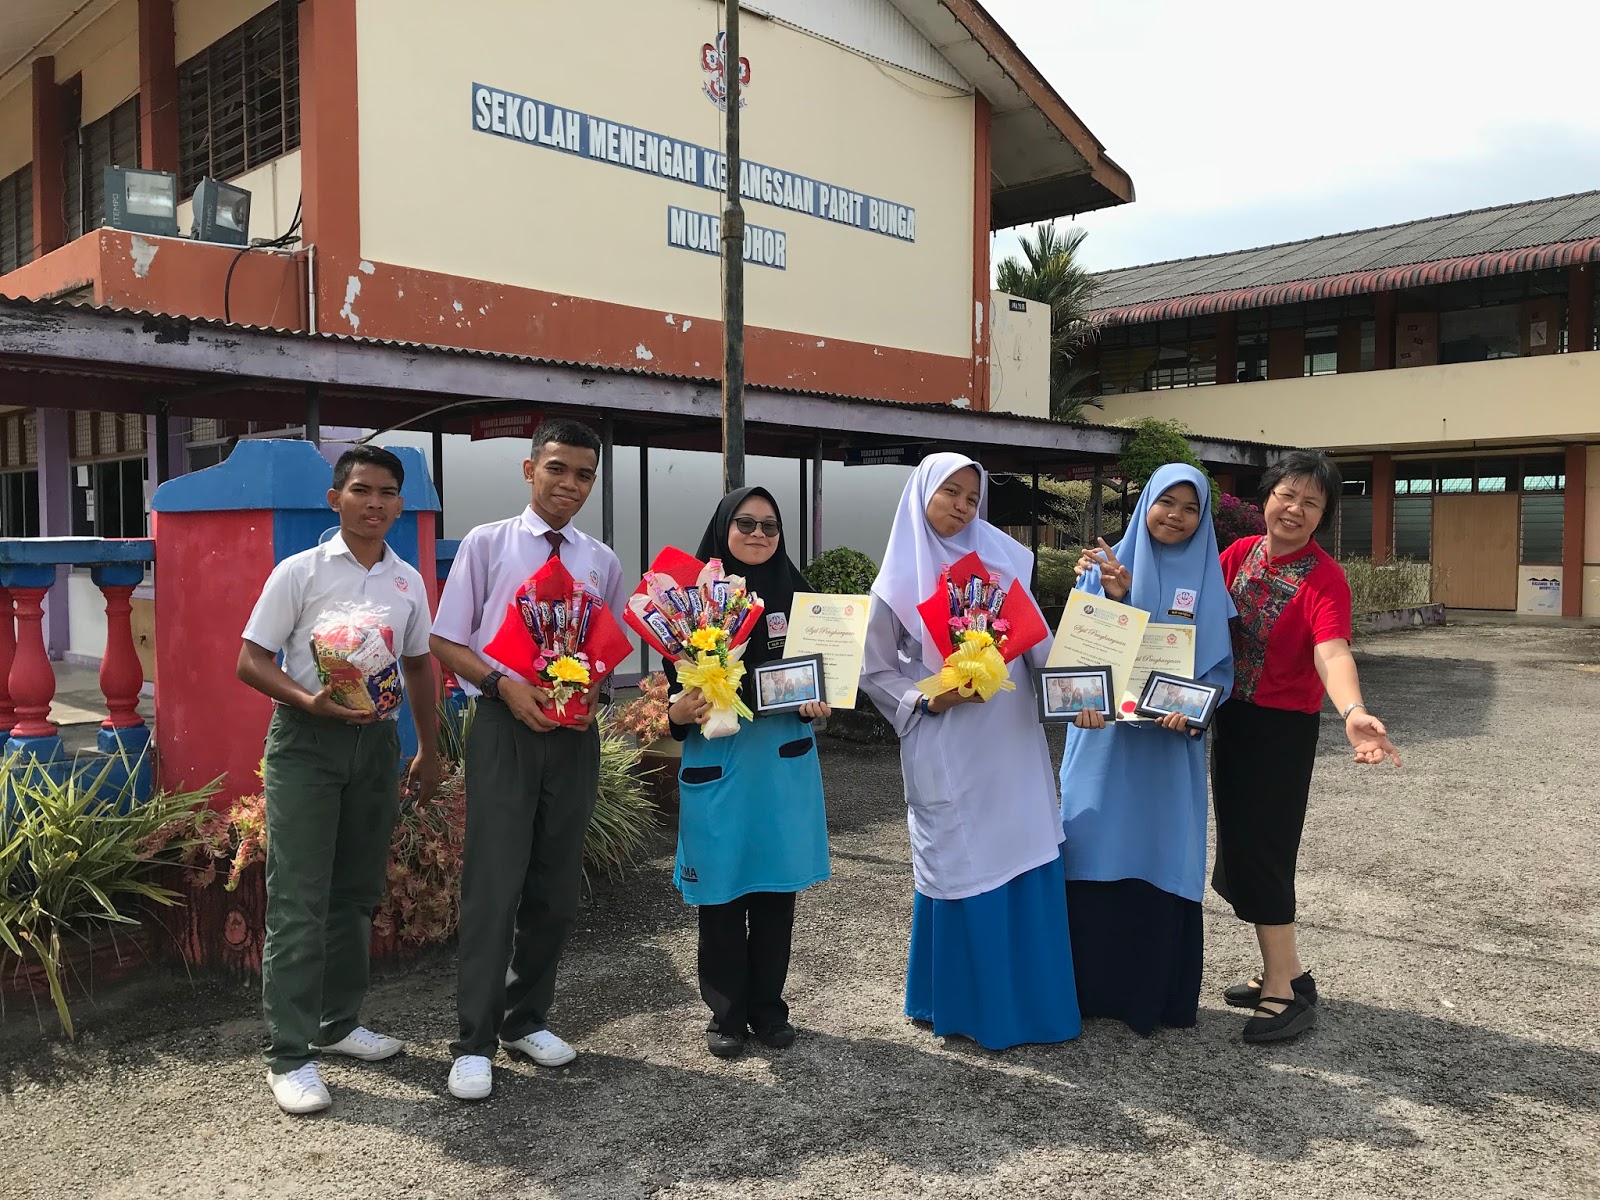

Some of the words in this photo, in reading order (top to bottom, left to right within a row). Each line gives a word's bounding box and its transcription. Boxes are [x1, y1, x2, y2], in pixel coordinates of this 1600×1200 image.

[475, 88, 580, 153] SEKOLAH
[588, 118, 697, 183] MENENGAH
[703, 150, 814, 214] KEANGSAAN
[819, 184, 863, 226] PARIT
[869, 198, 915, 240] BUNGA
[743, 224, 786, 268] OHOR
